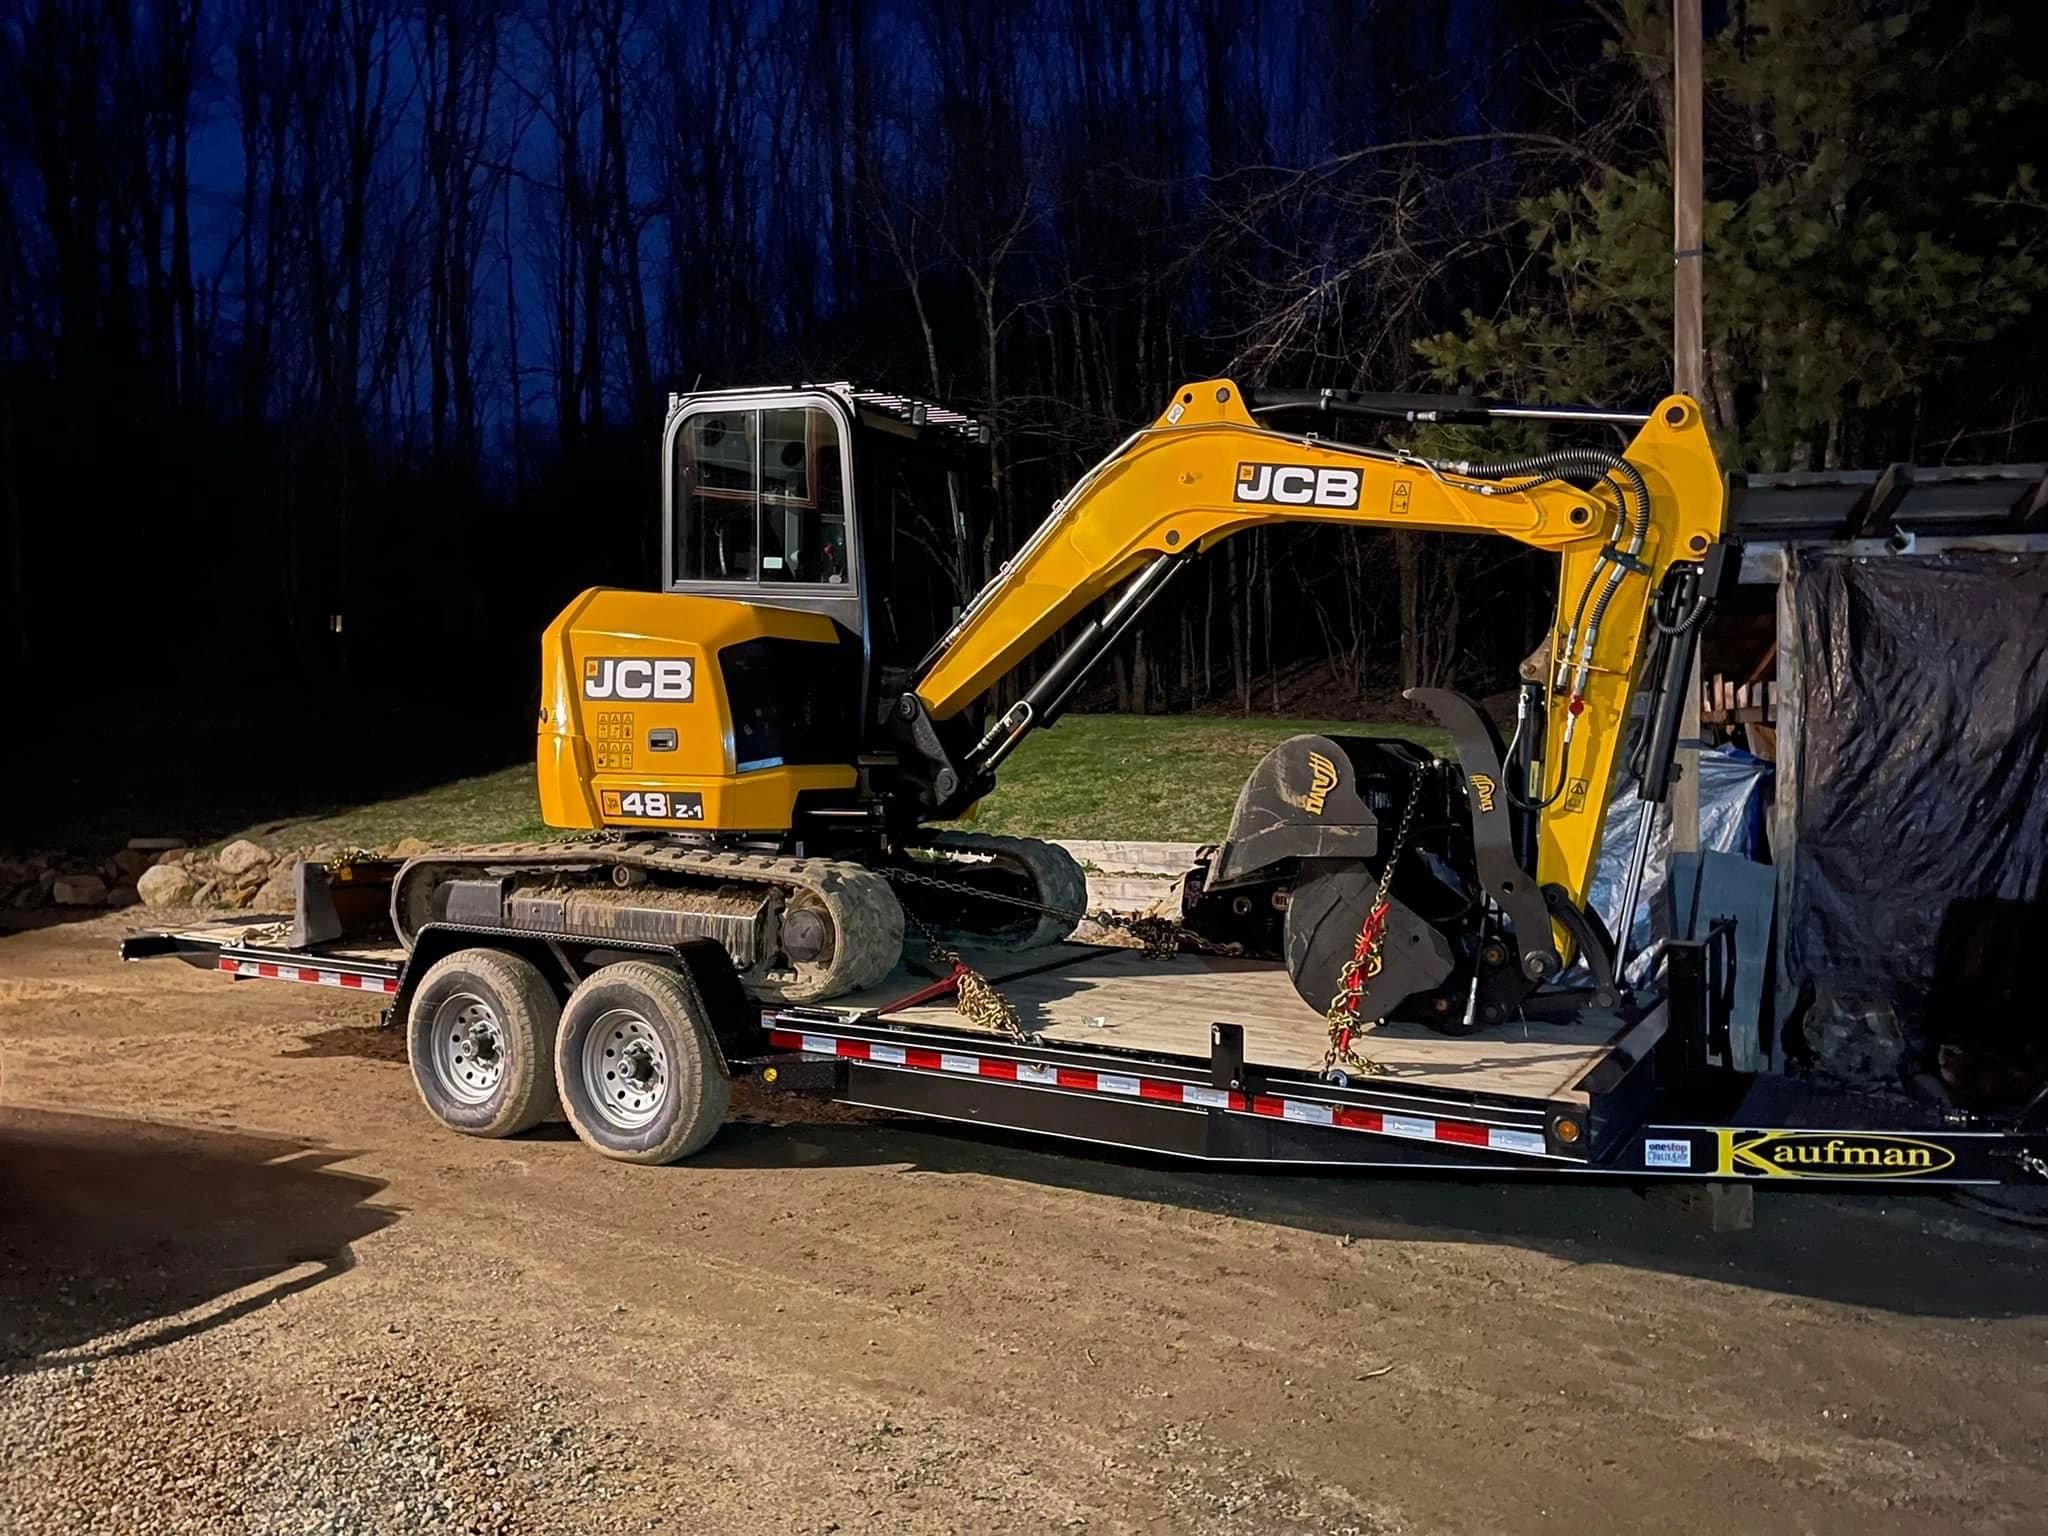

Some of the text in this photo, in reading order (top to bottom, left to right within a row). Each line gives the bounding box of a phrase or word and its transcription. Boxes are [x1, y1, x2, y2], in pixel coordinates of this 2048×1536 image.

[1237, 466, 1359, 507] JCB
[585, 660, 692, 699] JCB
[622, 792, 667, 817] 48
[1705, 1127, 1933, 1179] Kaufman
